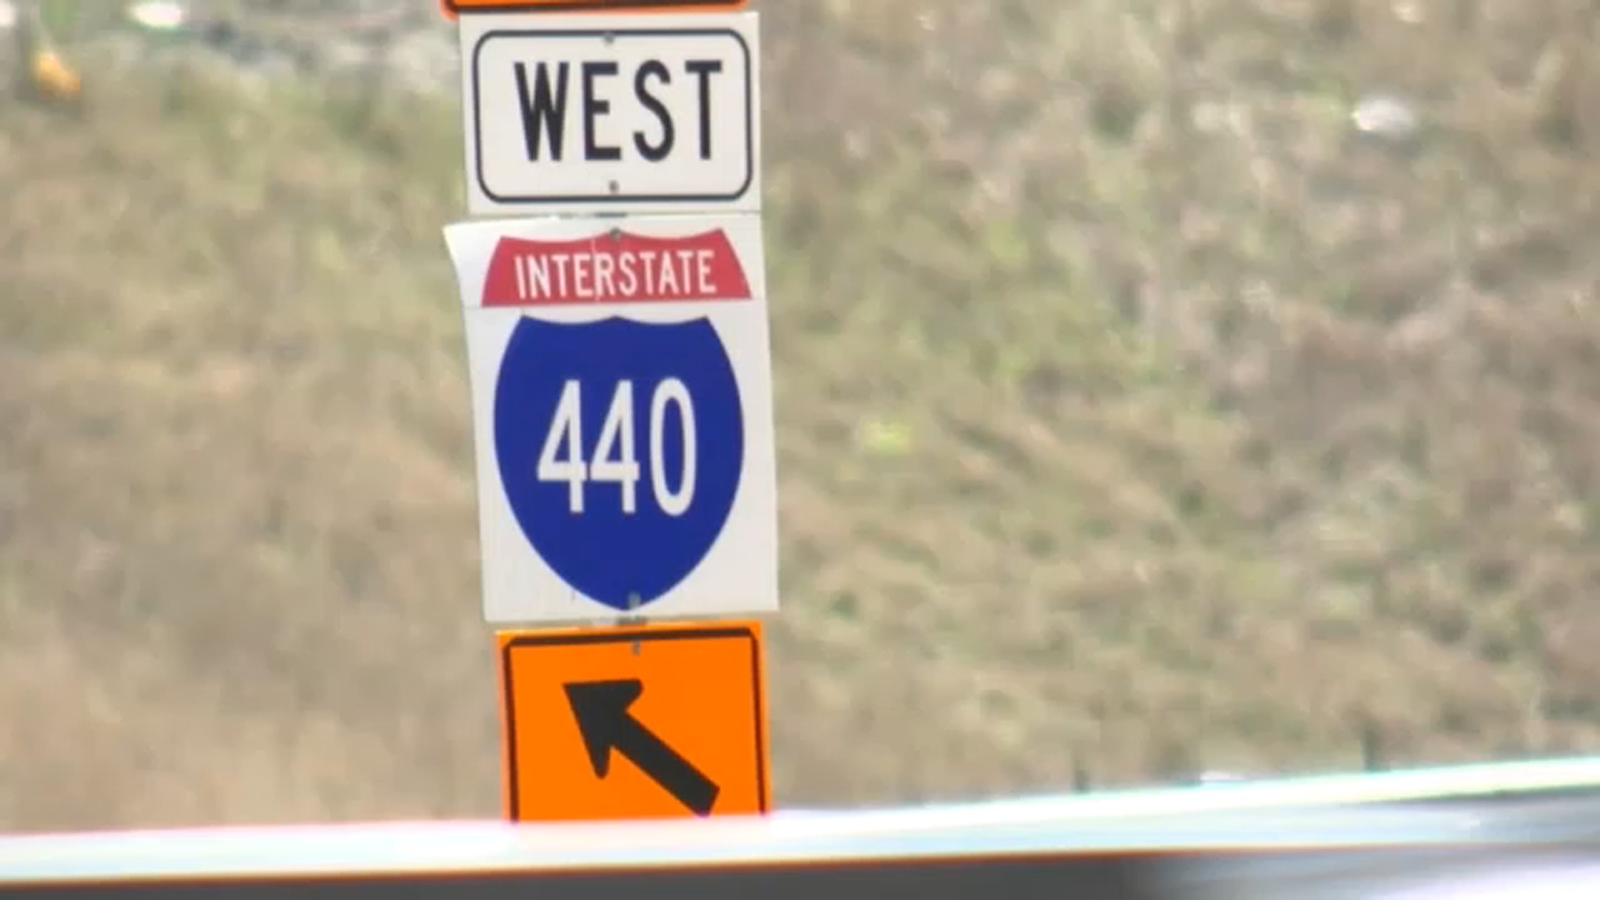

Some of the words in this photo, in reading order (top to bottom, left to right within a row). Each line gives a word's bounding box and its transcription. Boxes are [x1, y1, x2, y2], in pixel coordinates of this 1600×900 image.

[513, 59, 723, 162] WEST
[513, 250, 718, 300] INTERSTATE
[536, 377, 697, 517] 440
